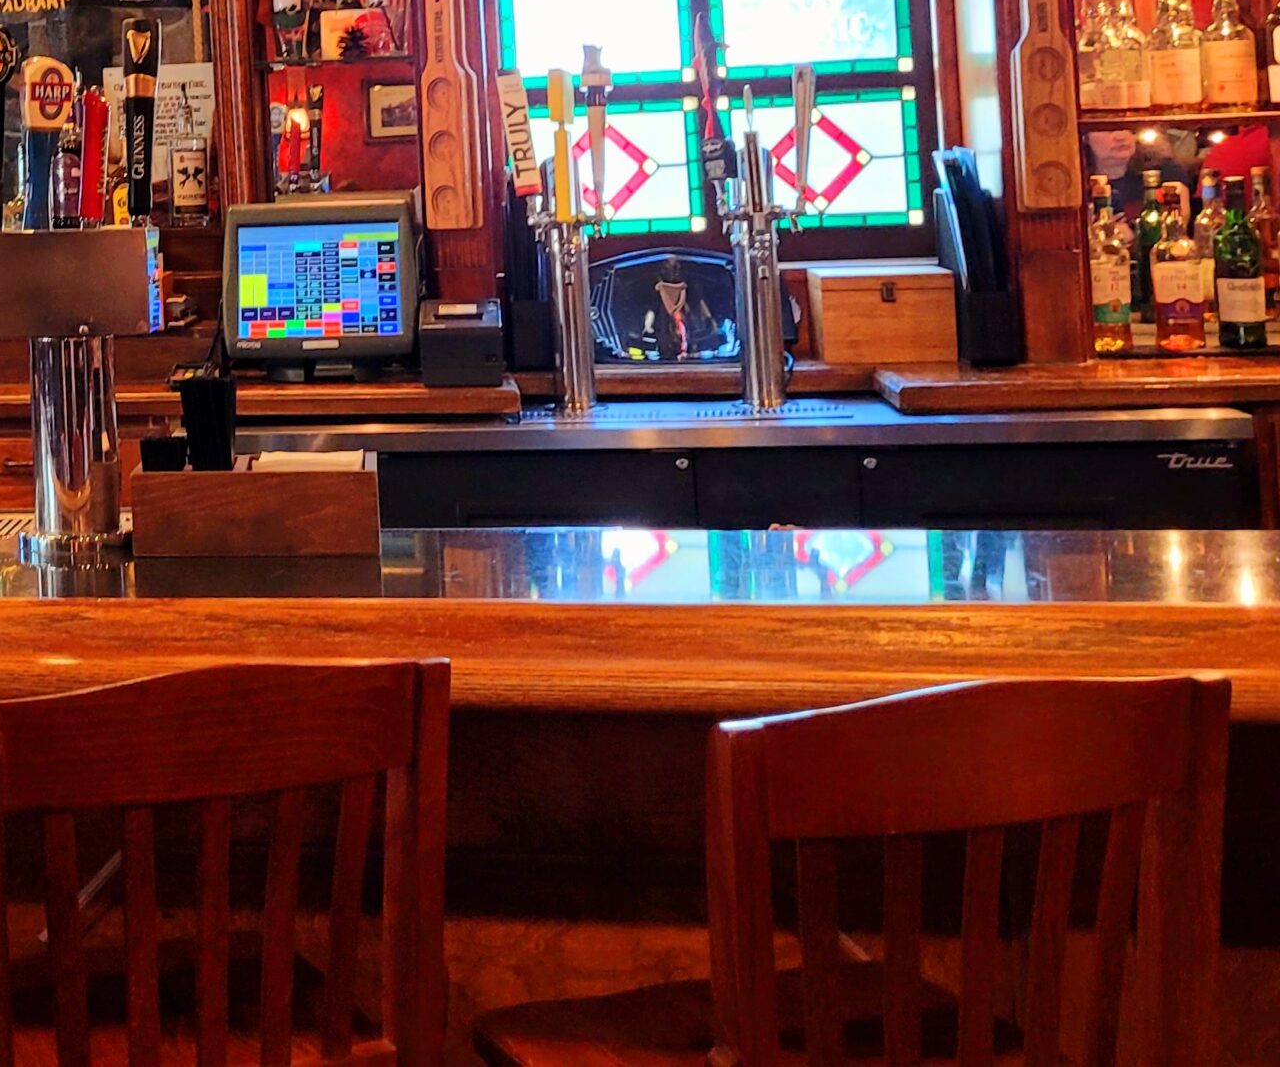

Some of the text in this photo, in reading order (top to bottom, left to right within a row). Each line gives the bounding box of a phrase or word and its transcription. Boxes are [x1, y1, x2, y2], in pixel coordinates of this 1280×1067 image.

[34, 84, 70, 100] HARP
[131, 114, 145, 180] GUINNESS
[503, 101, 537, 179] TRULY
